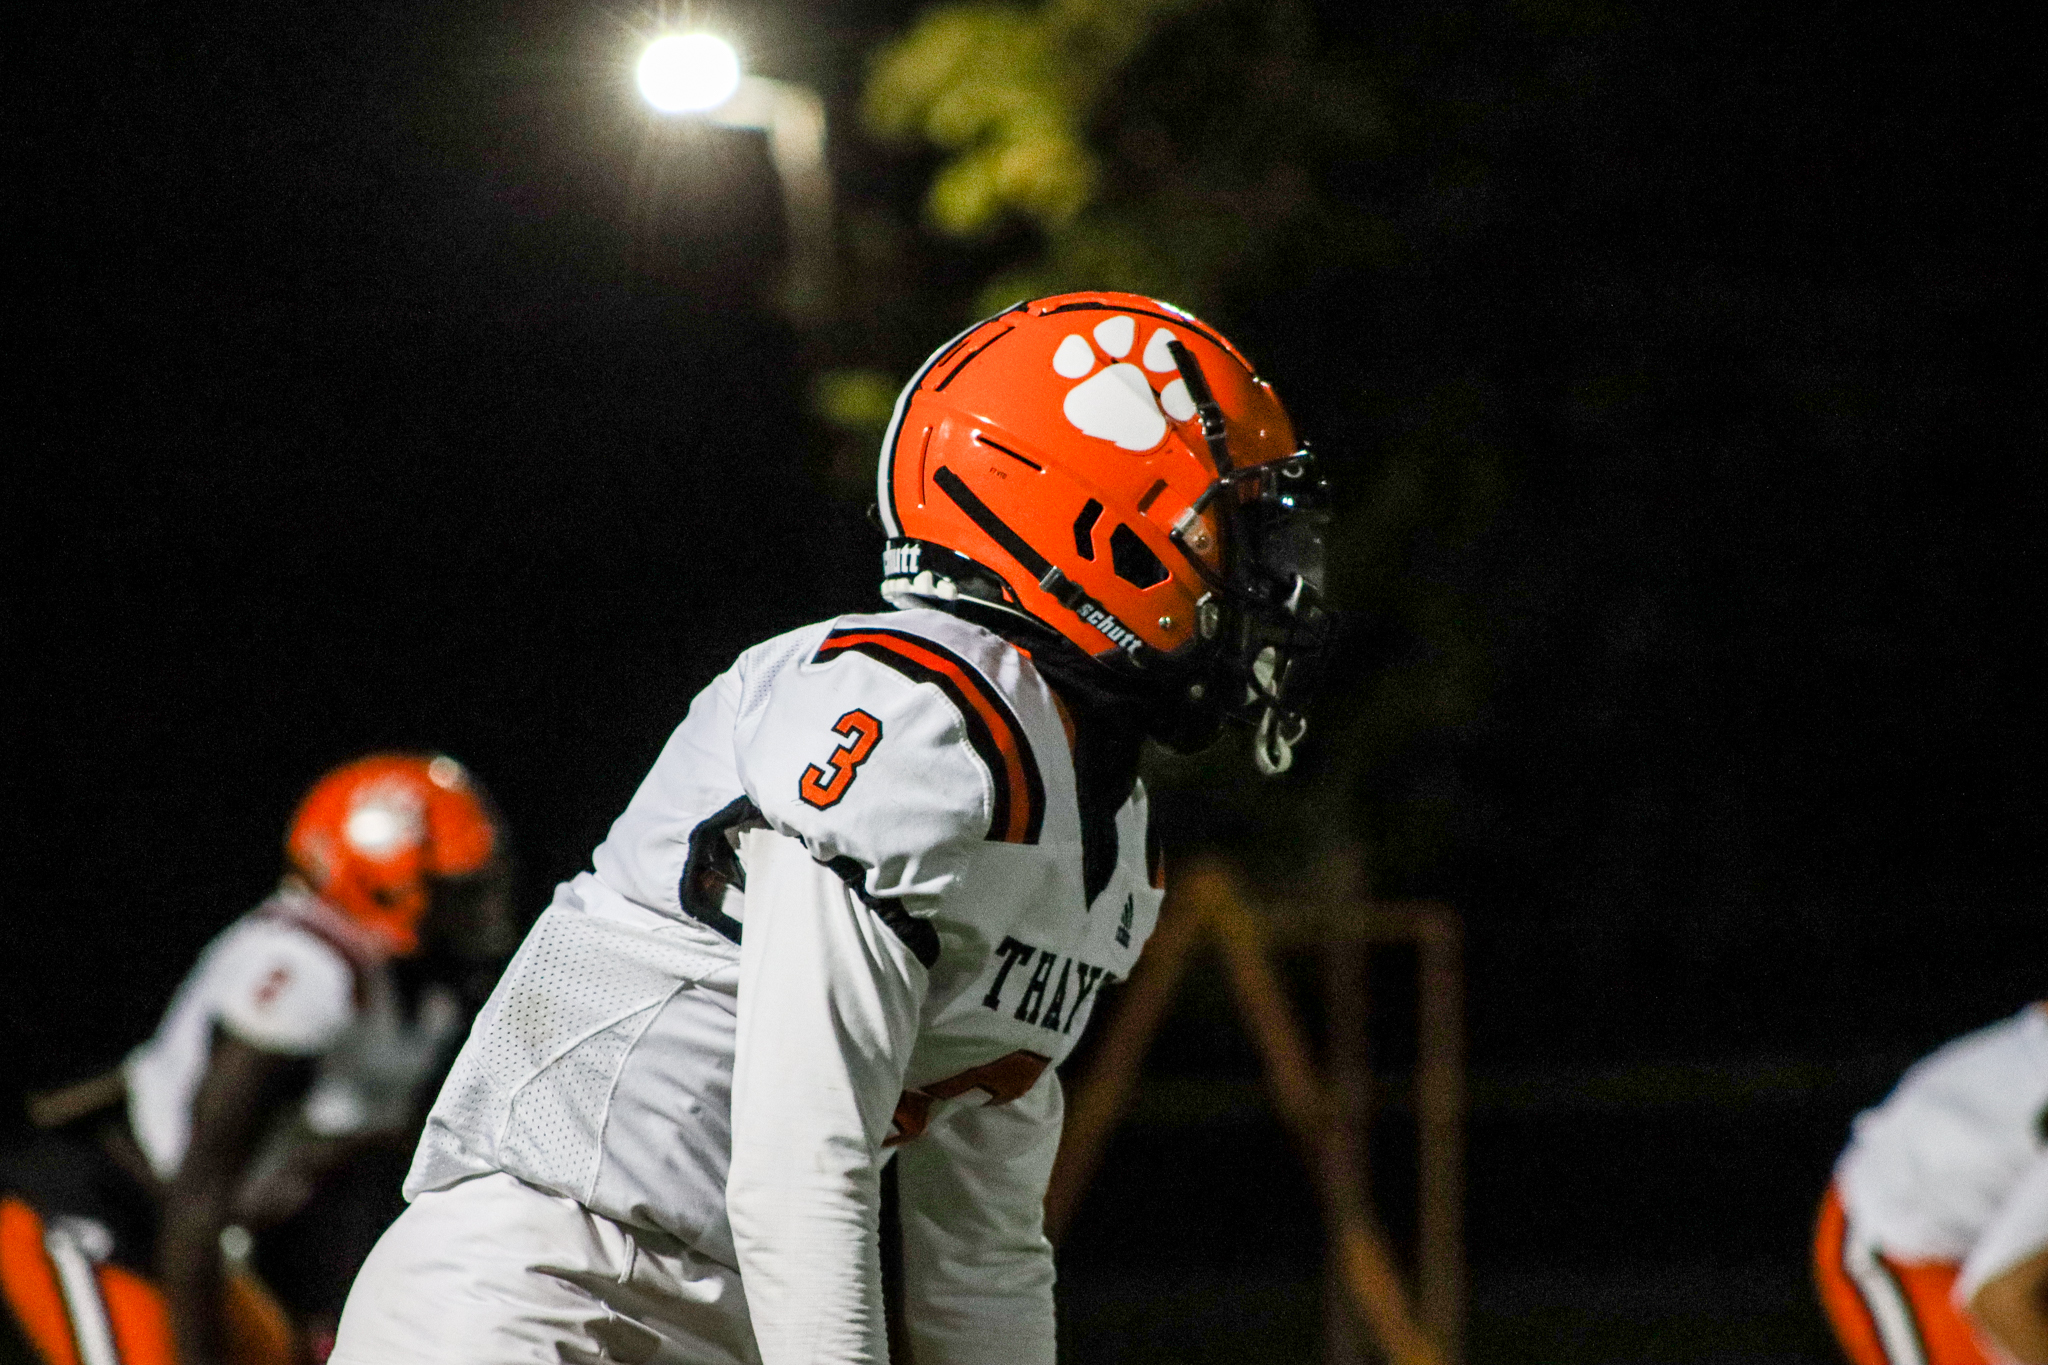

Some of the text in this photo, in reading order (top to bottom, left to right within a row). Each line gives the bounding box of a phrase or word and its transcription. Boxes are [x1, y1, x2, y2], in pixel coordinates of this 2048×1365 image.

[1077, 603, 1142, 654] schutt
[799, 708, 883, 811] 3
[982, 935, 1118, 1034] THAY
